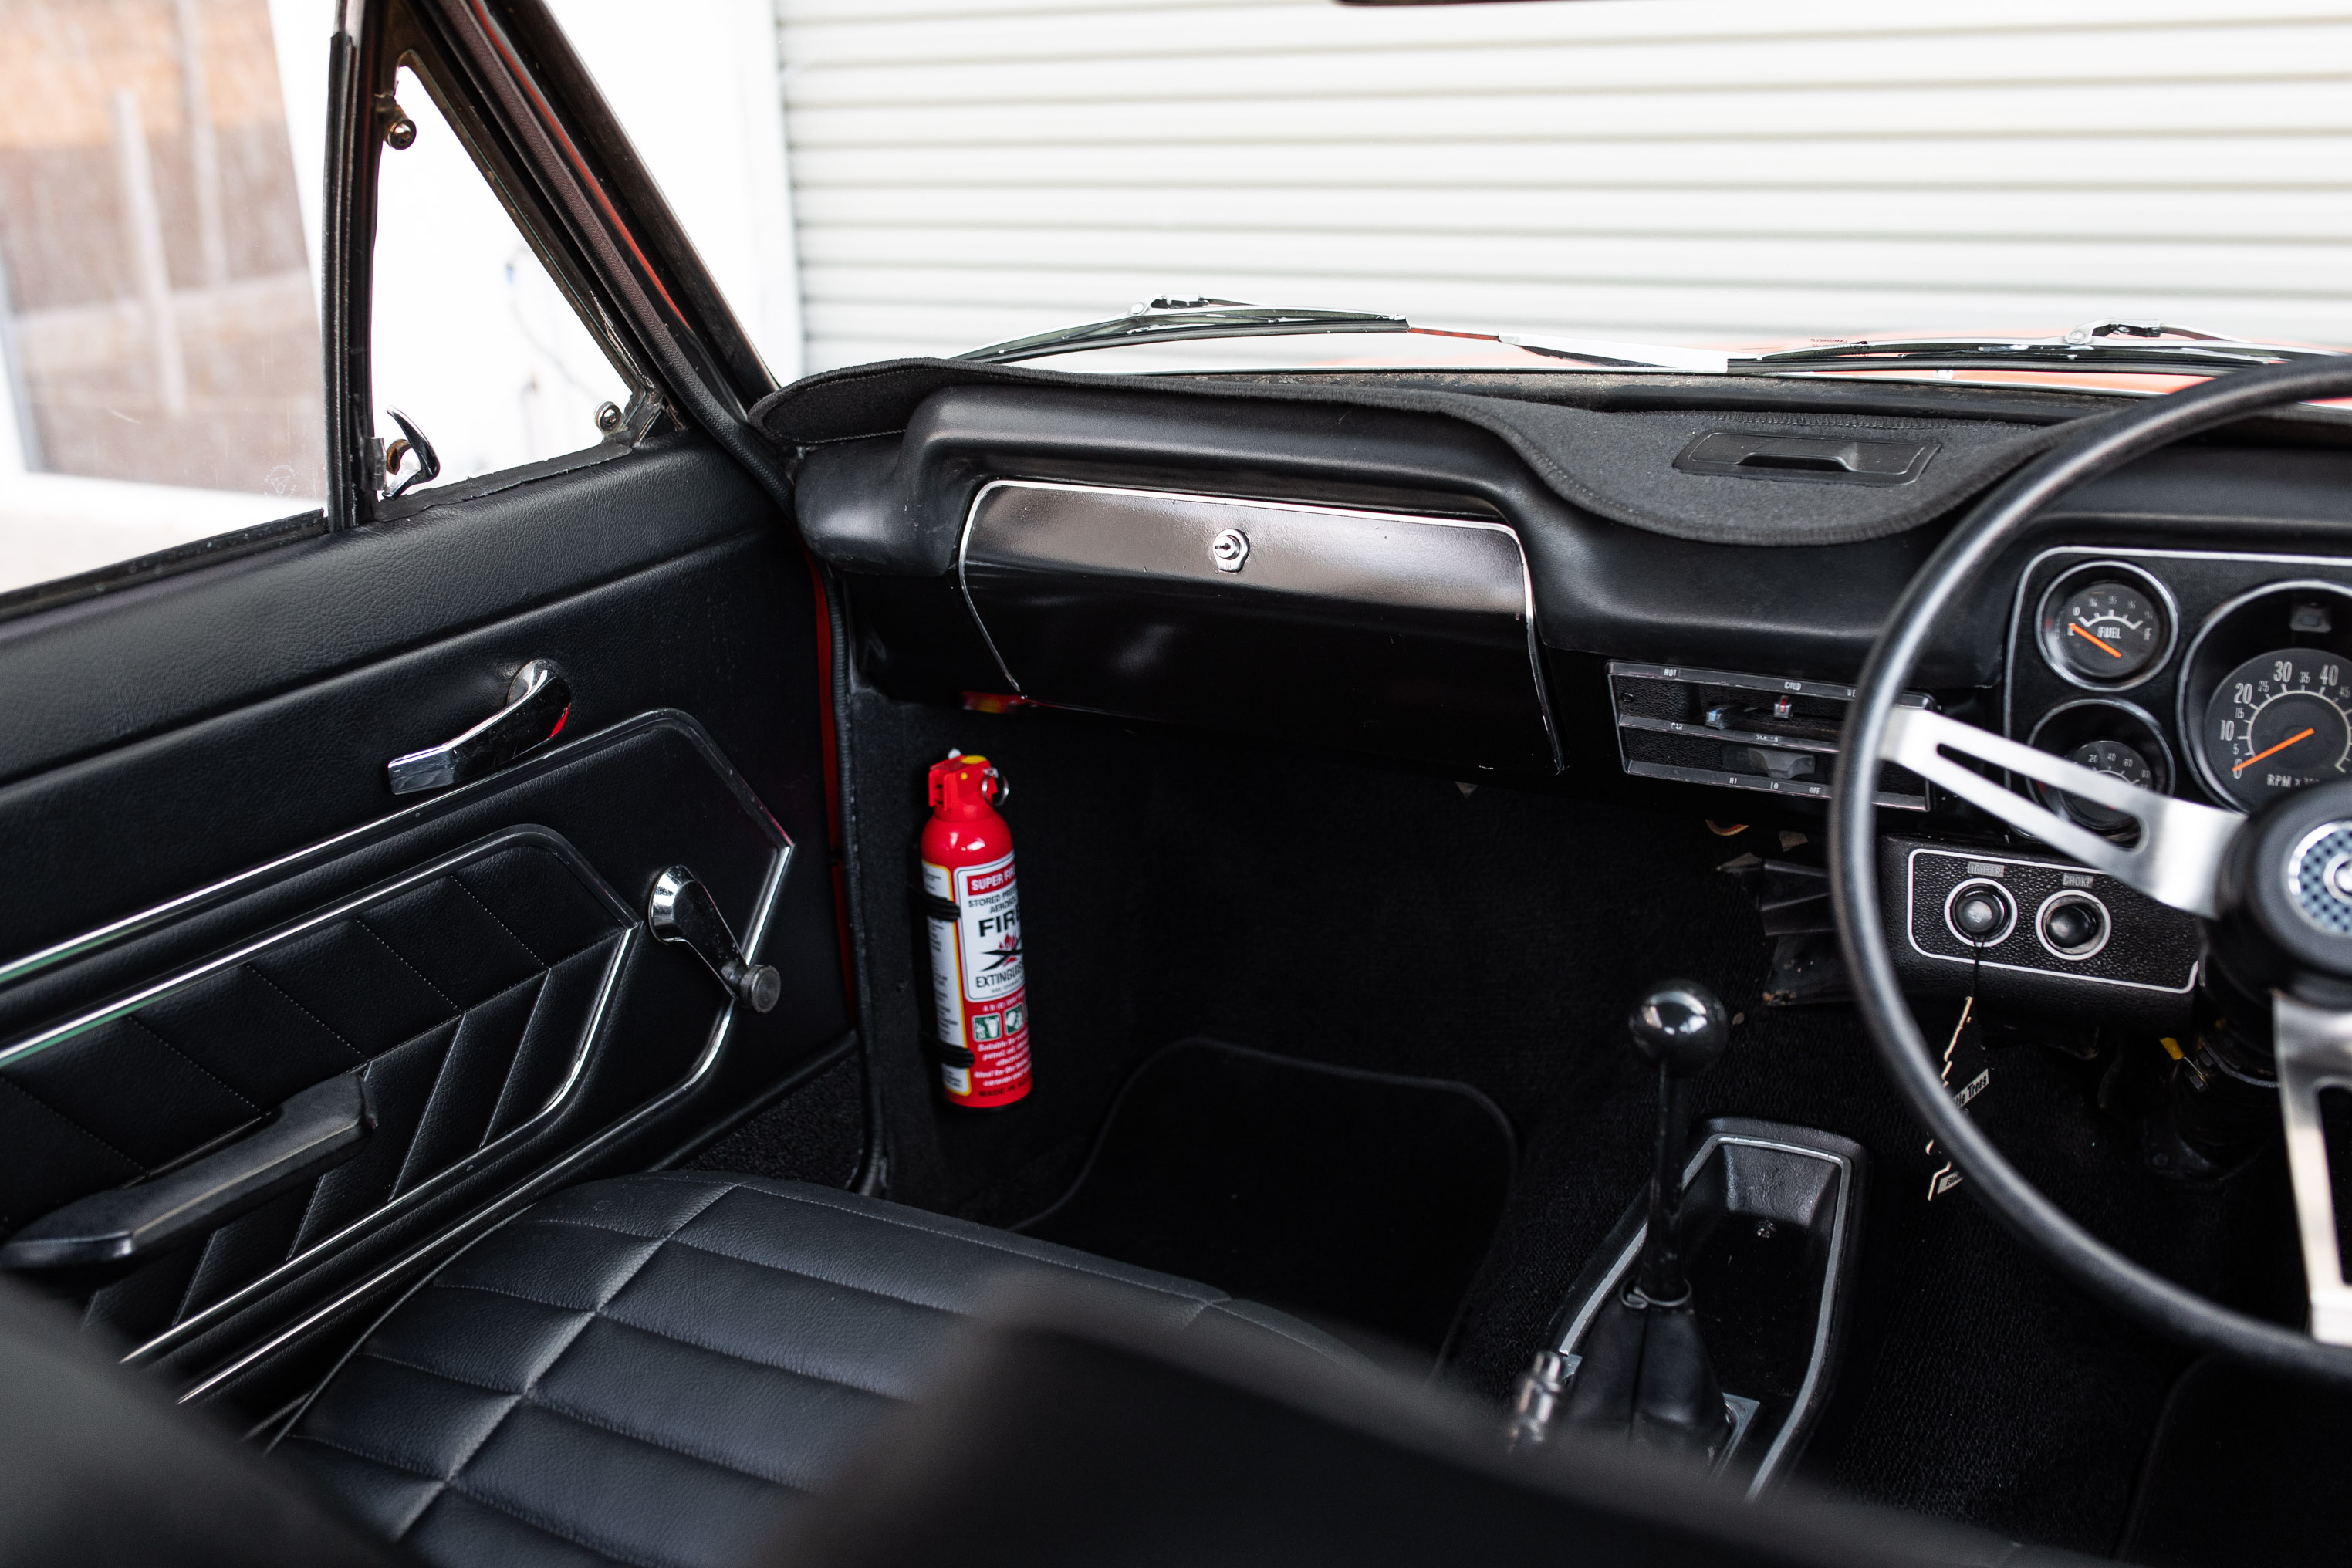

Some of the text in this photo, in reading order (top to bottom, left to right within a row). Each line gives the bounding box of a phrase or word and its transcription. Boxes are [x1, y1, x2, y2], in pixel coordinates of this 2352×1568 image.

[2097, 627, 2121, 639] FUEL
[2273, 661, 2293, 682] 30
[2320, 664, 2339, 686] 40
[2234, 683, 2252, 705] 20
[2220, 720, 2235, 741] 10
[2232, 743, 2239, 755] 5
[2088, 755, 2098, 763] 20
[2107, 753, 2117, 762] 40
[2233, 758, 2243, 779] 0
[2266, 773, 2292, 787] RPM
[1968, 862, 2002, 877] LIGHTER
[971, 873, 1004, 891] SUPER
[2063, 874, 2093, 887] CHOKE
[968, 894, 1001, 907] STORED
[1967, 1076, 1987, 1099] Trees
